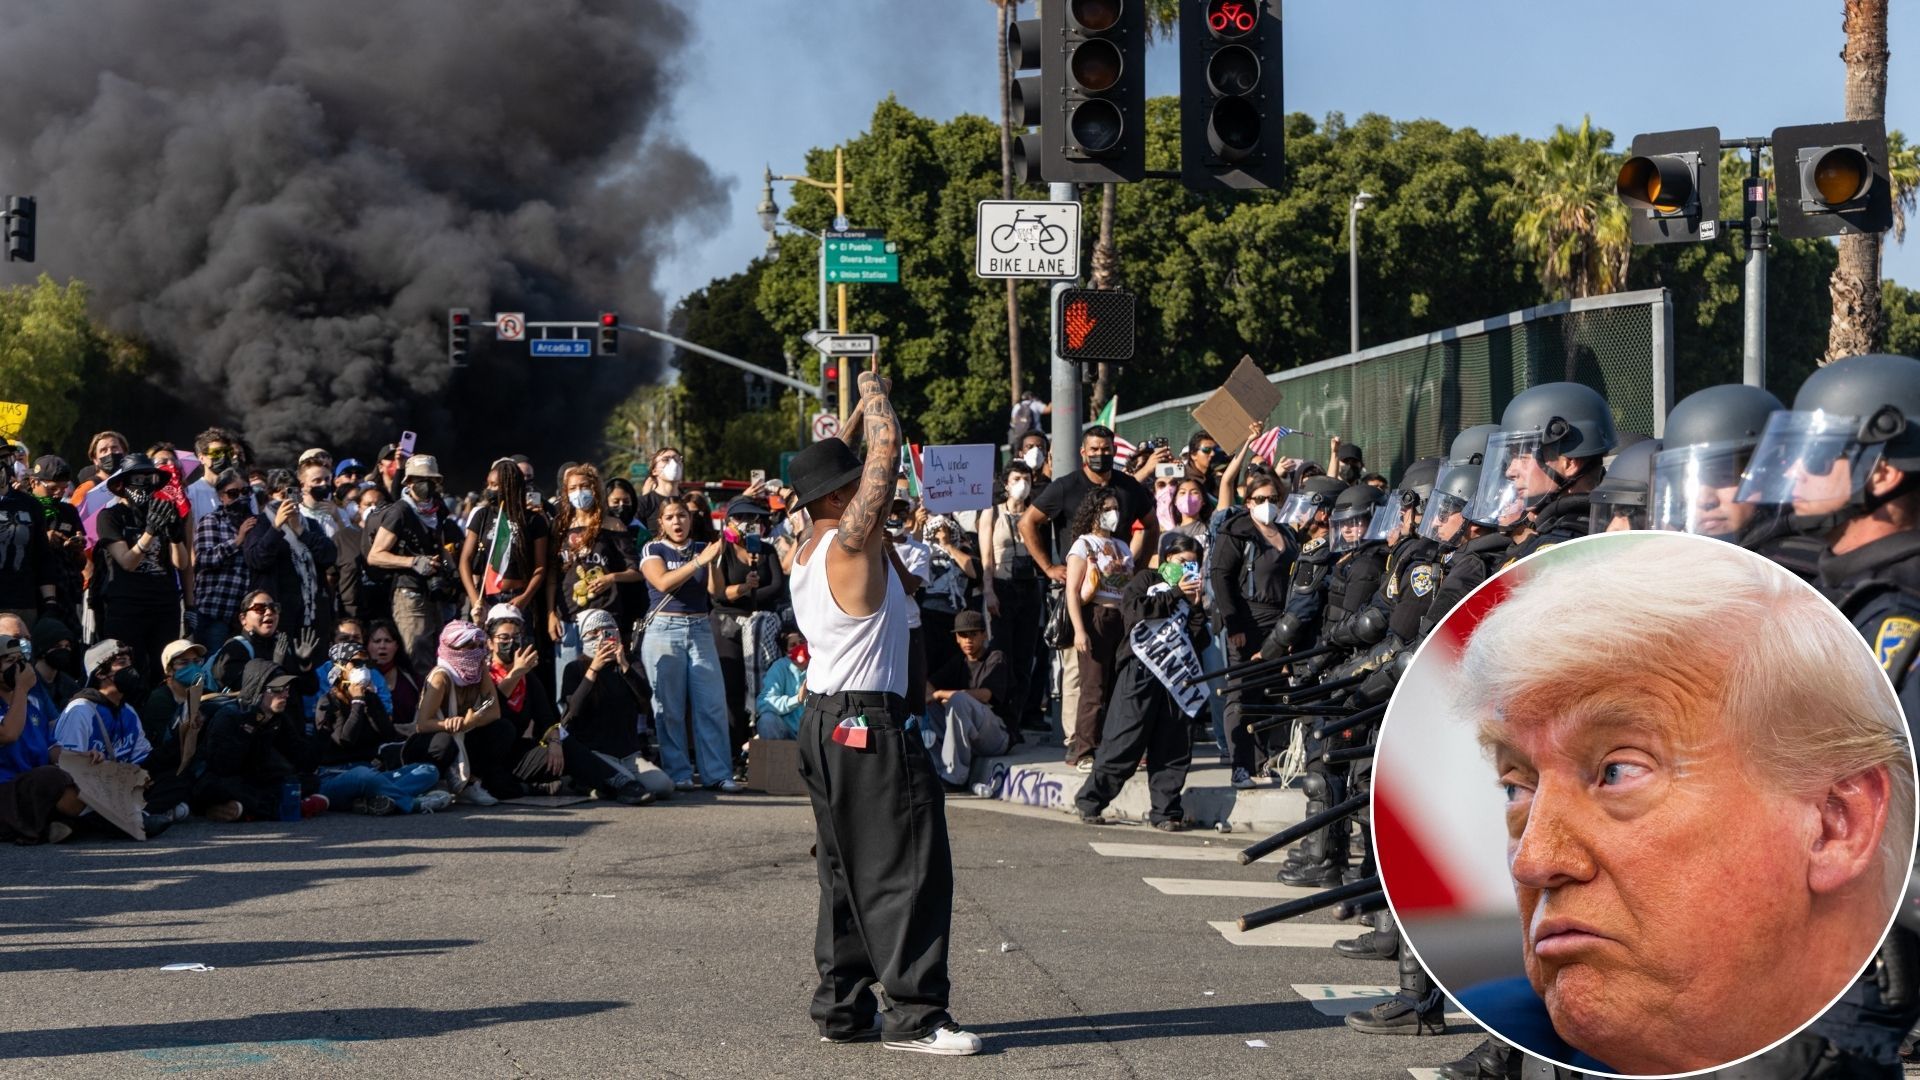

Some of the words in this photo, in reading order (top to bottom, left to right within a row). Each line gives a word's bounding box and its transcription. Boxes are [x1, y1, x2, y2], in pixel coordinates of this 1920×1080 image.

[840, 243, 847, 251] El
[849, 243, 873, 251] Pueblo
[990, 258, 1021, 271] BIKE
[1028, 258, 1064, 272] LANE
[537, 344, 571, 352] Arcadia
[574, 344, 584, 352] St
[931, 449, 945, 471] LA
[1157, 621, 1188, 651] BUT
[1181, 651, 1200, 676] NO
[1134, 621, 1205, 707] UMANITY
